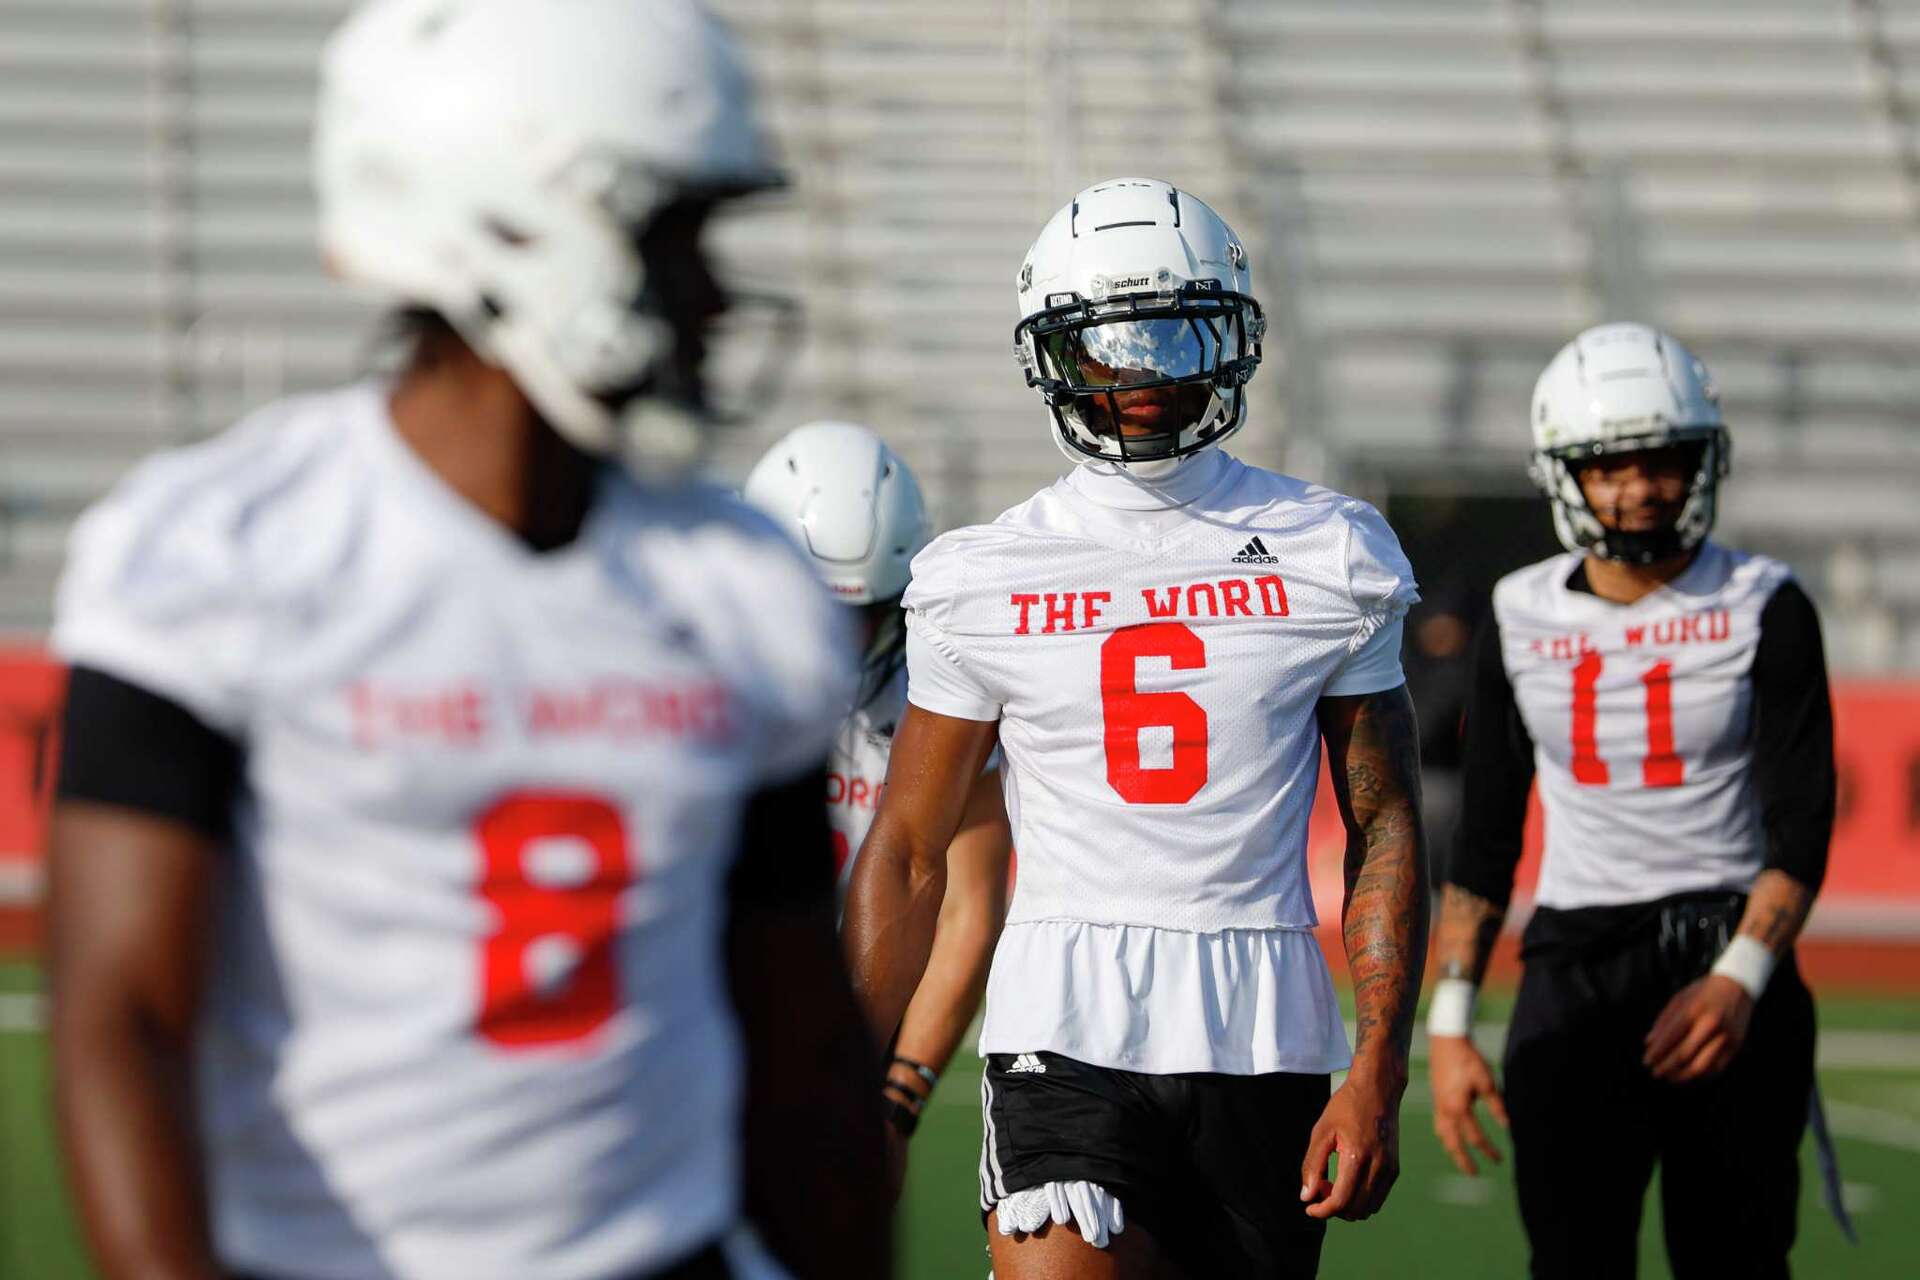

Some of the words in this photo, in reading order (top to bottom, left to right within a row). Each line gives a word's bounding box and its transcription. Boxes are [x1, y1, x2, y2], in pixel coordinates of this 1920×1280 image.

[1114, 277, 1150, 289] schutt
[1231, 554, 1279, 564] adidas
[1100, 622, 1209, 805] 6
[1568, 650, 1686, 788] 11
[472, 787, 634, 1052] 8
